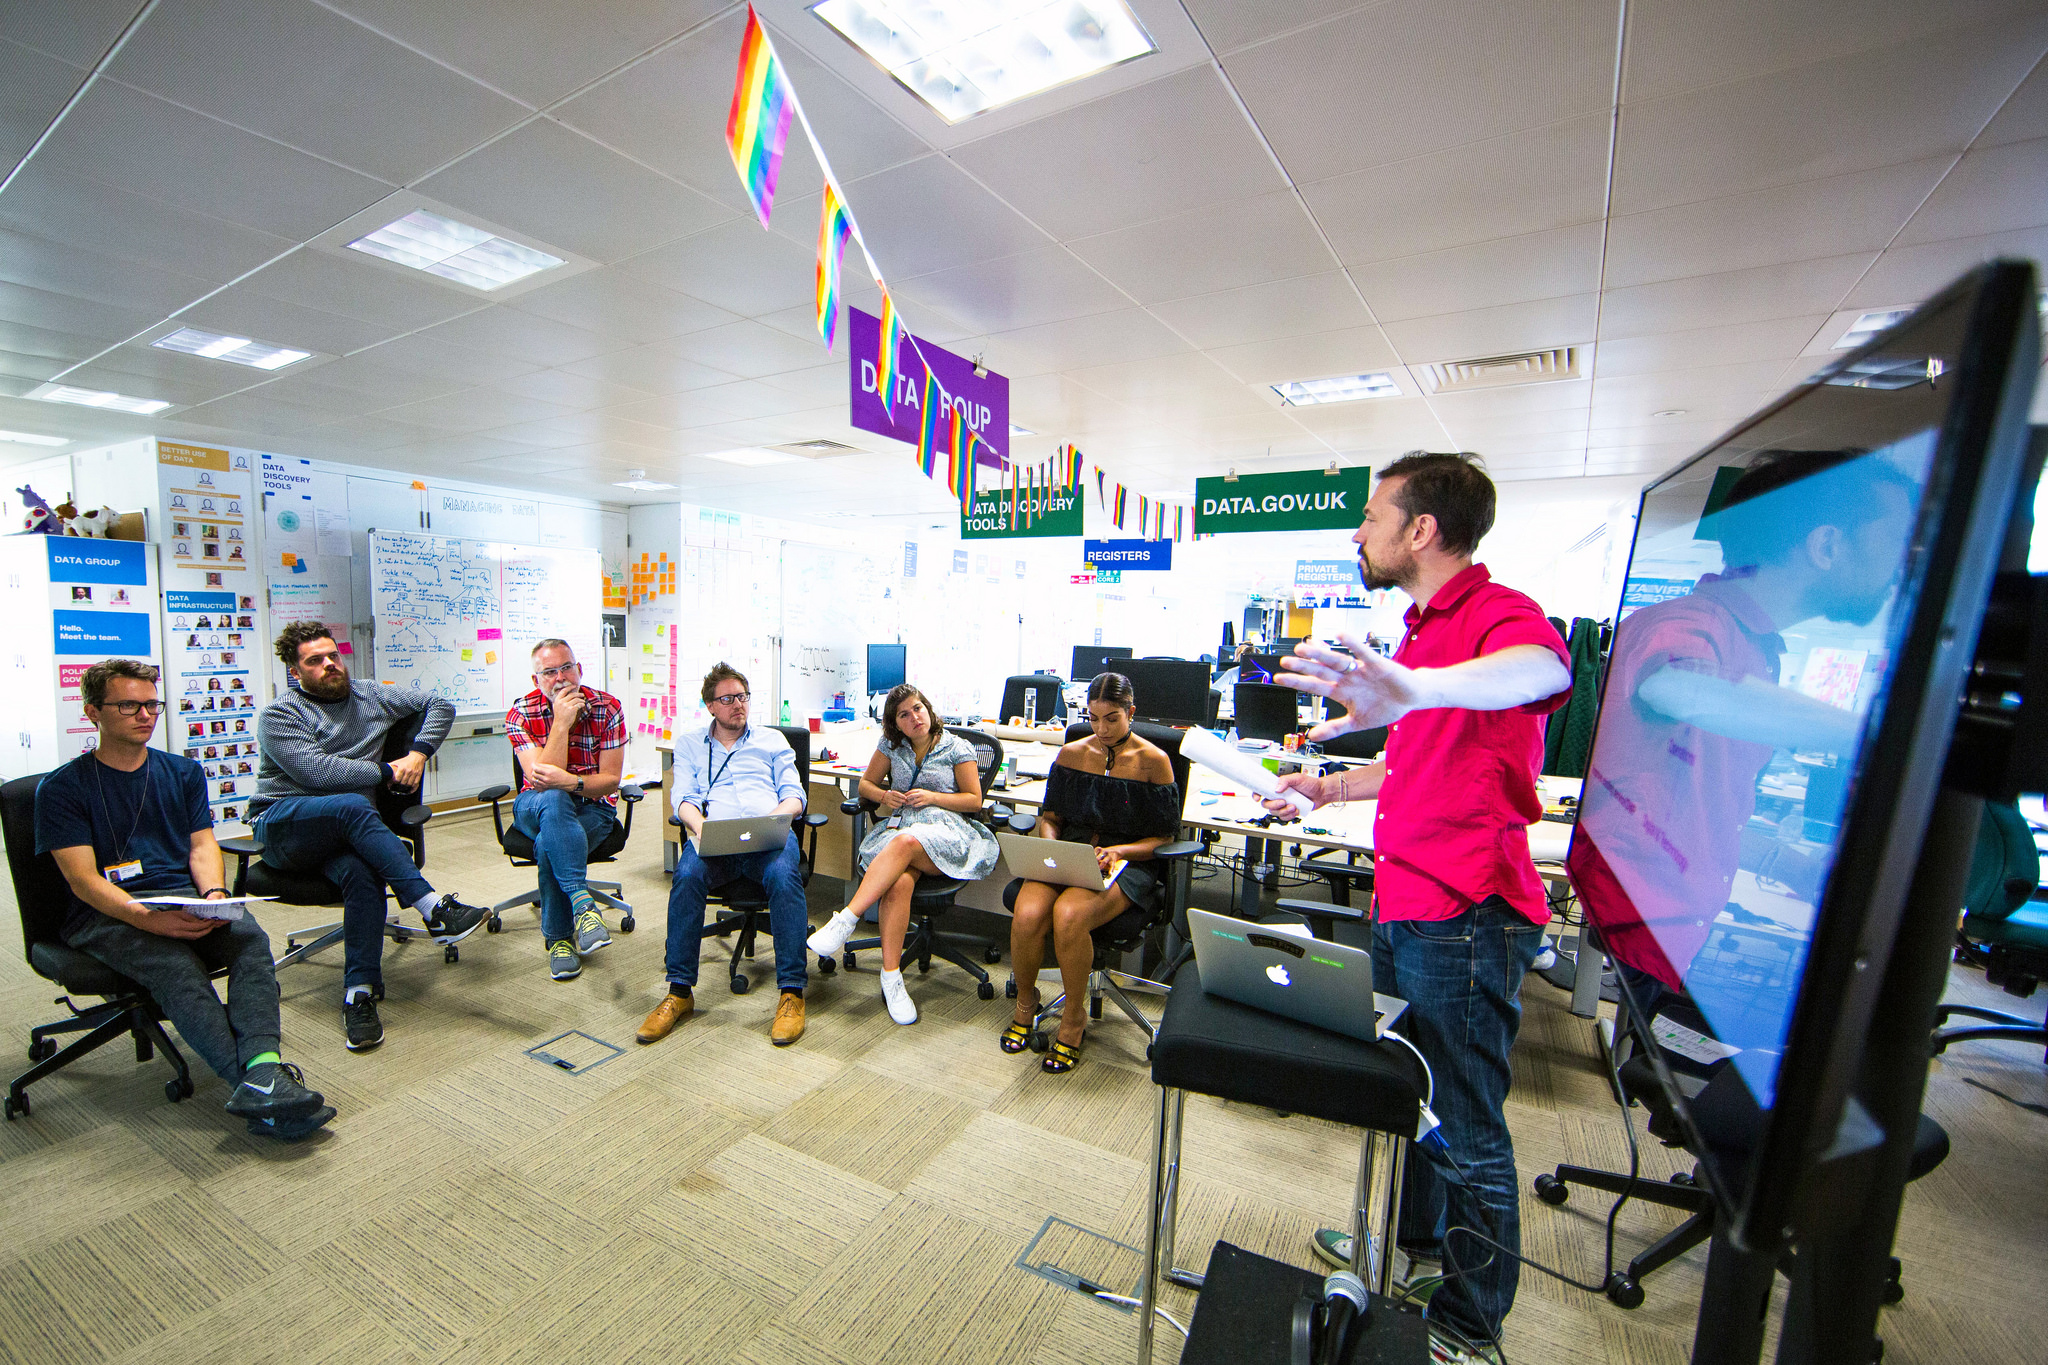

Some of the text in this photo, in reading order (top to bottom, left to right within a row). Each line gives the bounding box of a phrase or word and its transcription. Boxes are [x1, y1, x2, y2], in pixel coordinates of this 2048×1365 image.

[861, 358, 991, 432] DTA ROUP
[161, 446, 207, 458] BETTER USE
[263, 463, 285, 472] DATA
[263, 472, 311, 484] DISCOVERY
[264, 481, 292, 490] TOOLS
[443, 497, 503, 514] MANAGING
[968, 498, 1075, 515] ATA DICOERY
[1203, 491, 1347, 515] DATA.GOV.UK
[965, 518, 1007, 531] TOOLS
[54, 556, 121, 567] DATA GROUP
[1088, 551, 1150, 561] REGISTERS
[1298, 565, 1338, 573] PRIVATE
[1297, 573, 1353, 581] REGISTERS
[83, 633, 96, 641] the
